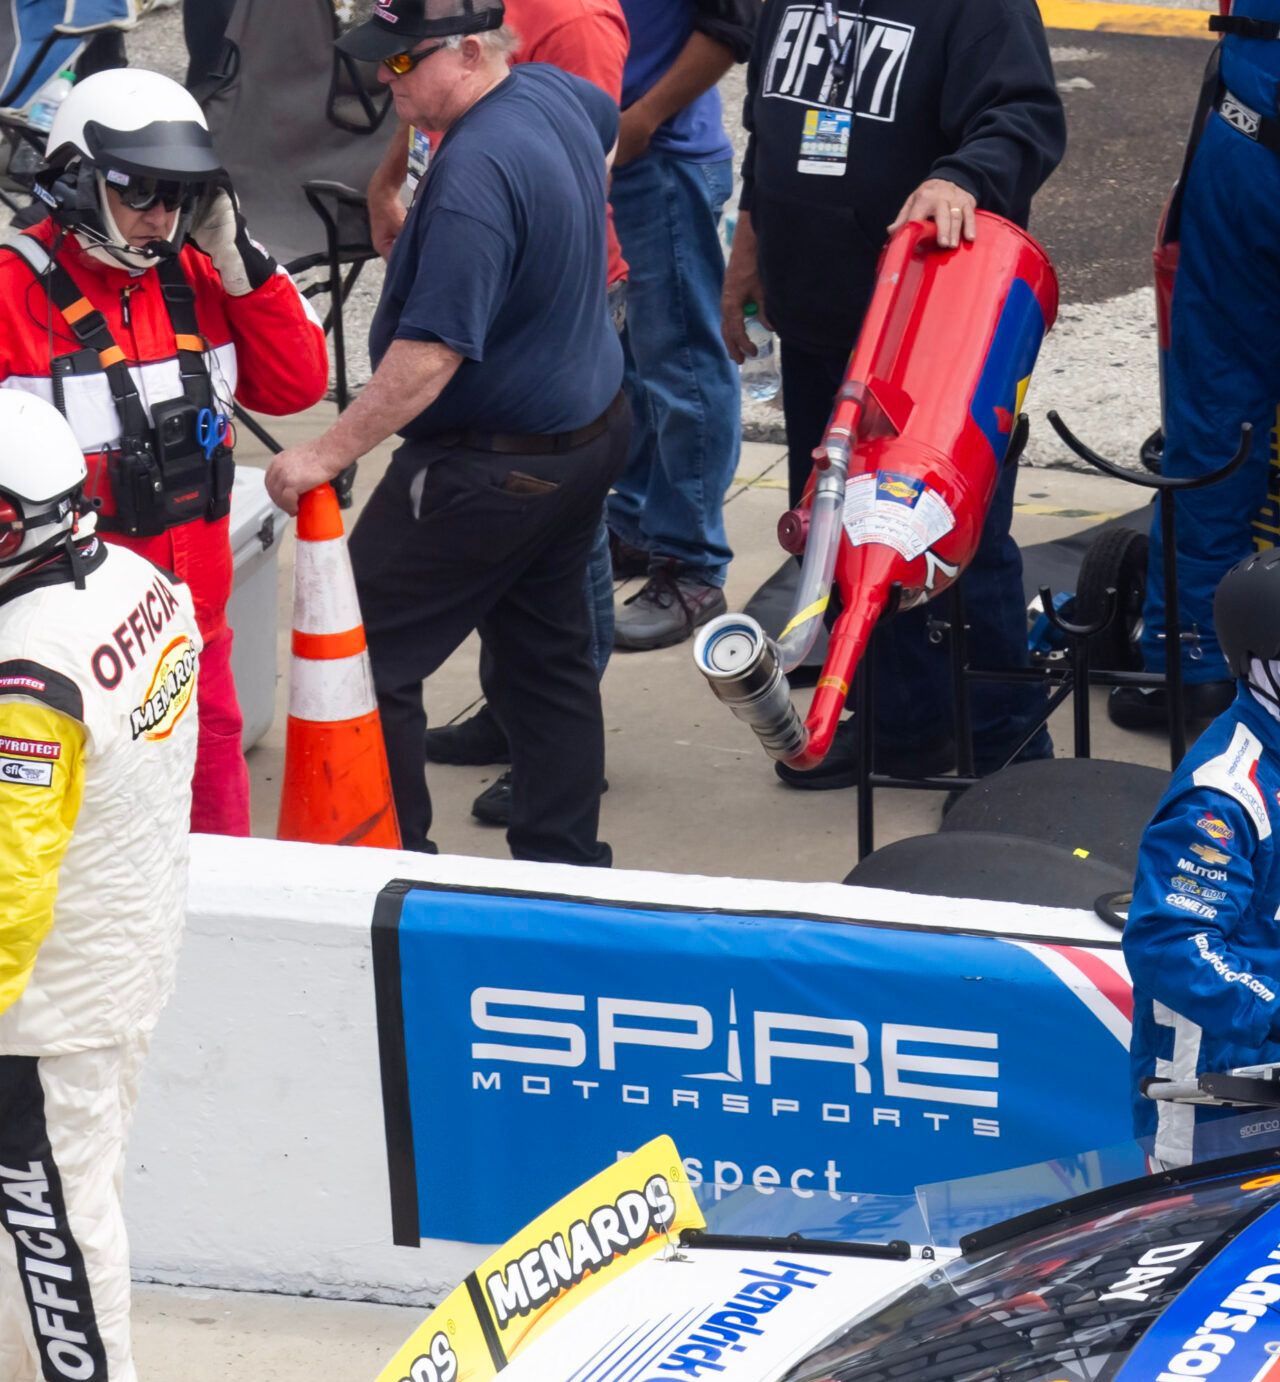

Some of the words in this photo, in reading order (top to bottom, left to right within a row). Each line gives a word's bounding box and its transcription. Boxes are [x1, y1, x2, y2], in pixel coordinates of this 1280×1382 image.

[90, 575, 180, 691] OFFICIA
[1176, 857, 1228, 882] MUTOH
[1165, 893, 1219, 920] COMETIC
[469, 985, 1000, 1109] SPIRE
[471, 1070, 1001, 1139] MOTORSPORTS
[616, 1148, 860, 1204] spect.
[1, 1159, 95, 1382] OFFICIAL
[486, 1172, 676, 1330] MENARDS
[1098, 1240, 1205, 1304] DAY
